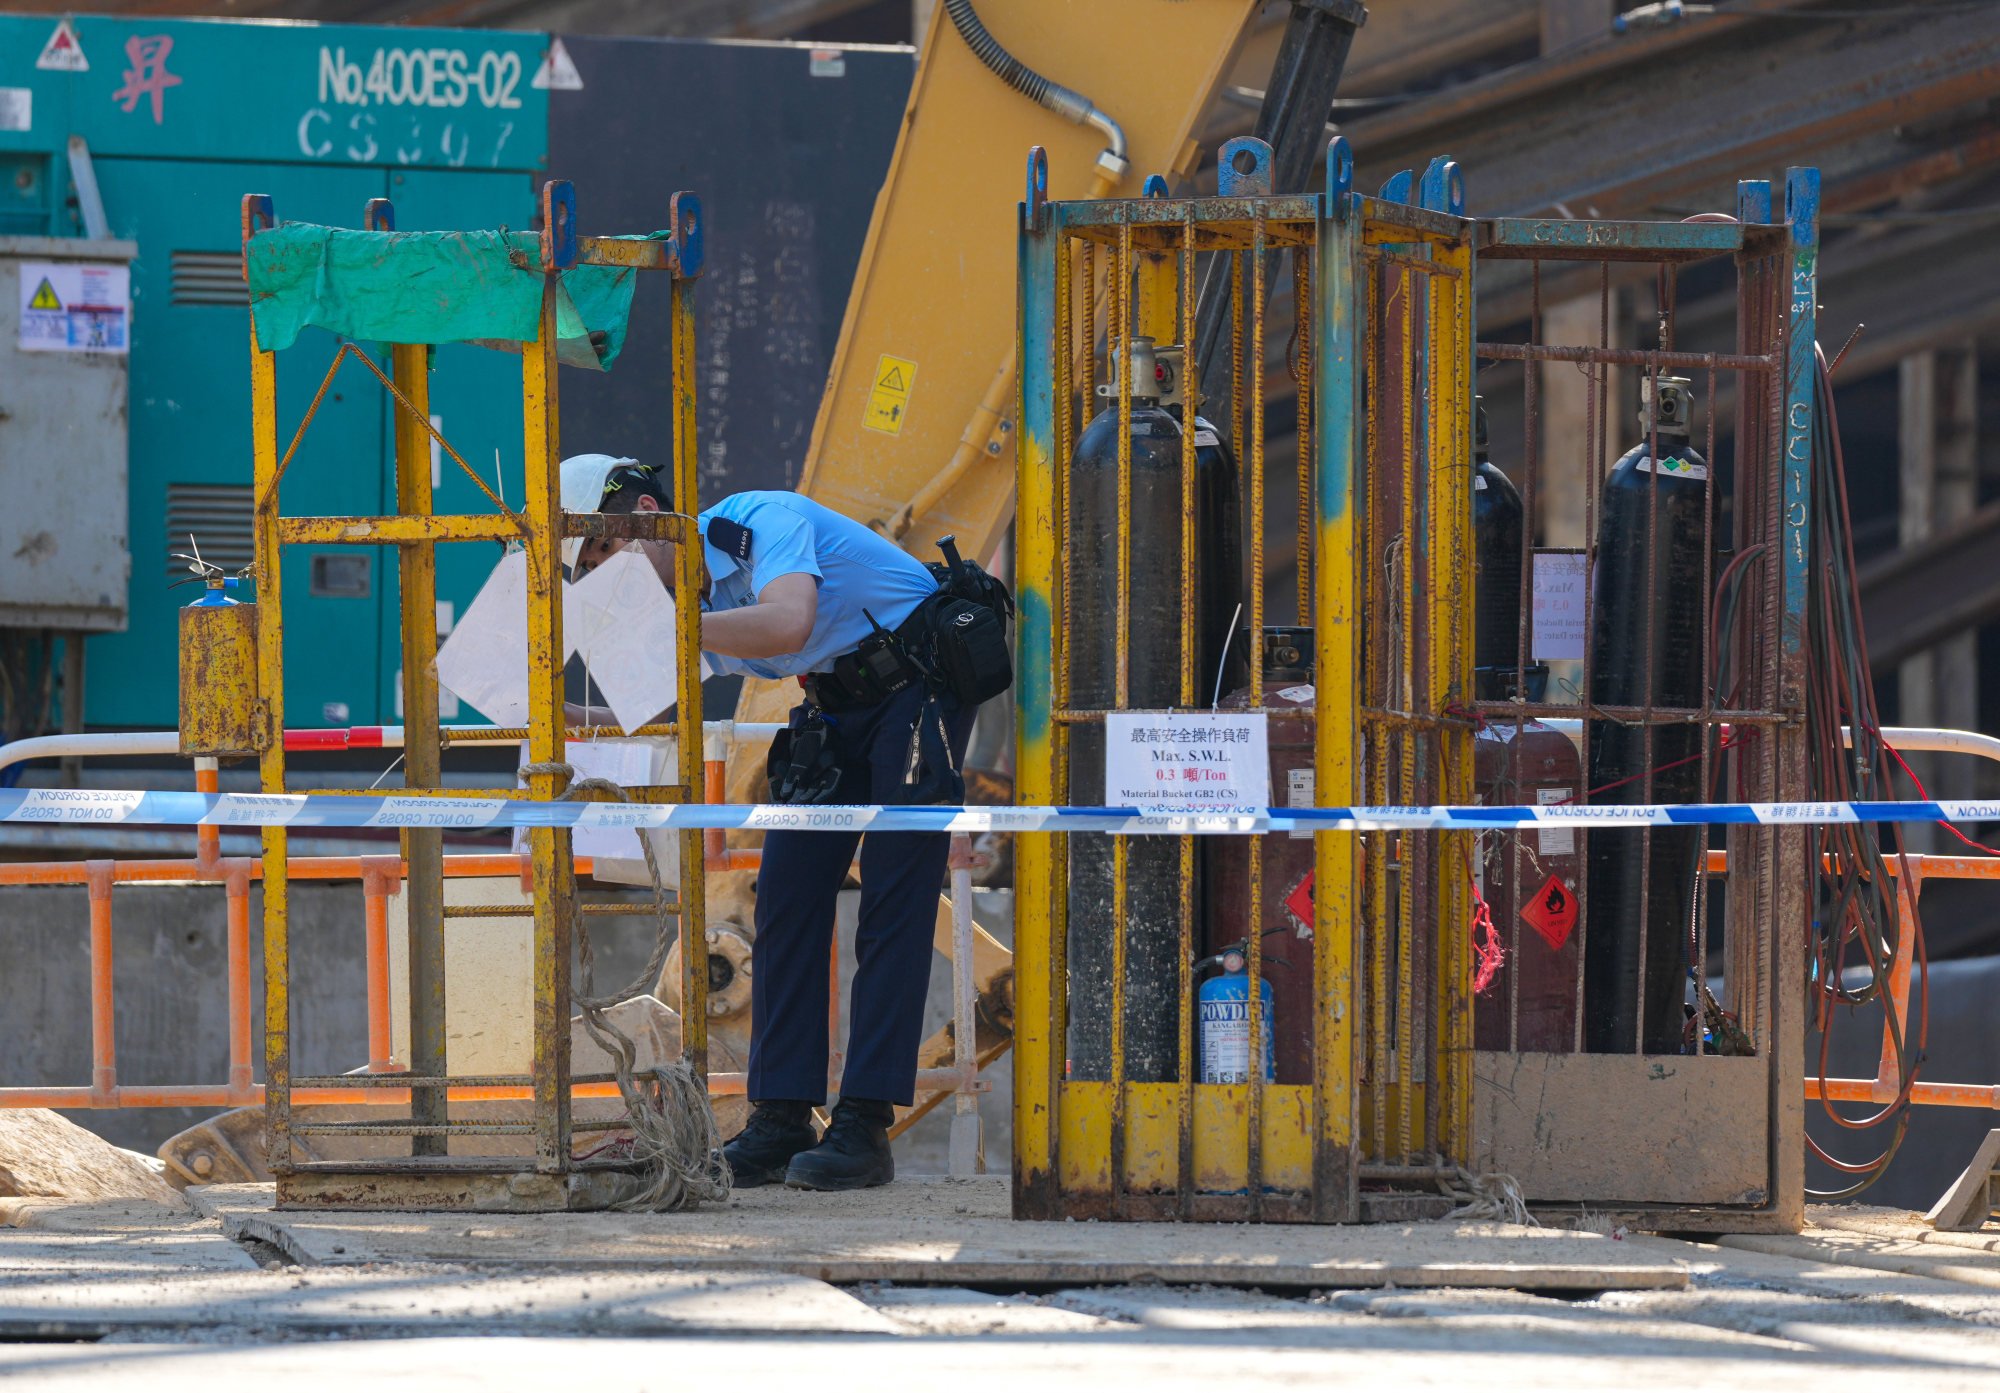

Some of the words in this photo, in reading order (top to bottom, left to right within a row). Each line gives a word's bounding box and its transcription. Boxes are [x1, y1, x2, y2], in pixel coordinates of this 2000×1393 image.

[319, 45, 522, 109] No.400ES-02
[739, 530, 748, 556] 61490
[1131, 728, 1250, 743] 最高安全操作負荷
[1151, 750, 1185, 762] Max.
[1188, 750, 1232, 762] S.W.L.
[1156, 769, 1175, 781] 0.3
[1121, 789, 1160, 798] Material
[1162, 789, 1192, 798] Bucket
[1216, 788, 1239, 800] (CS)
